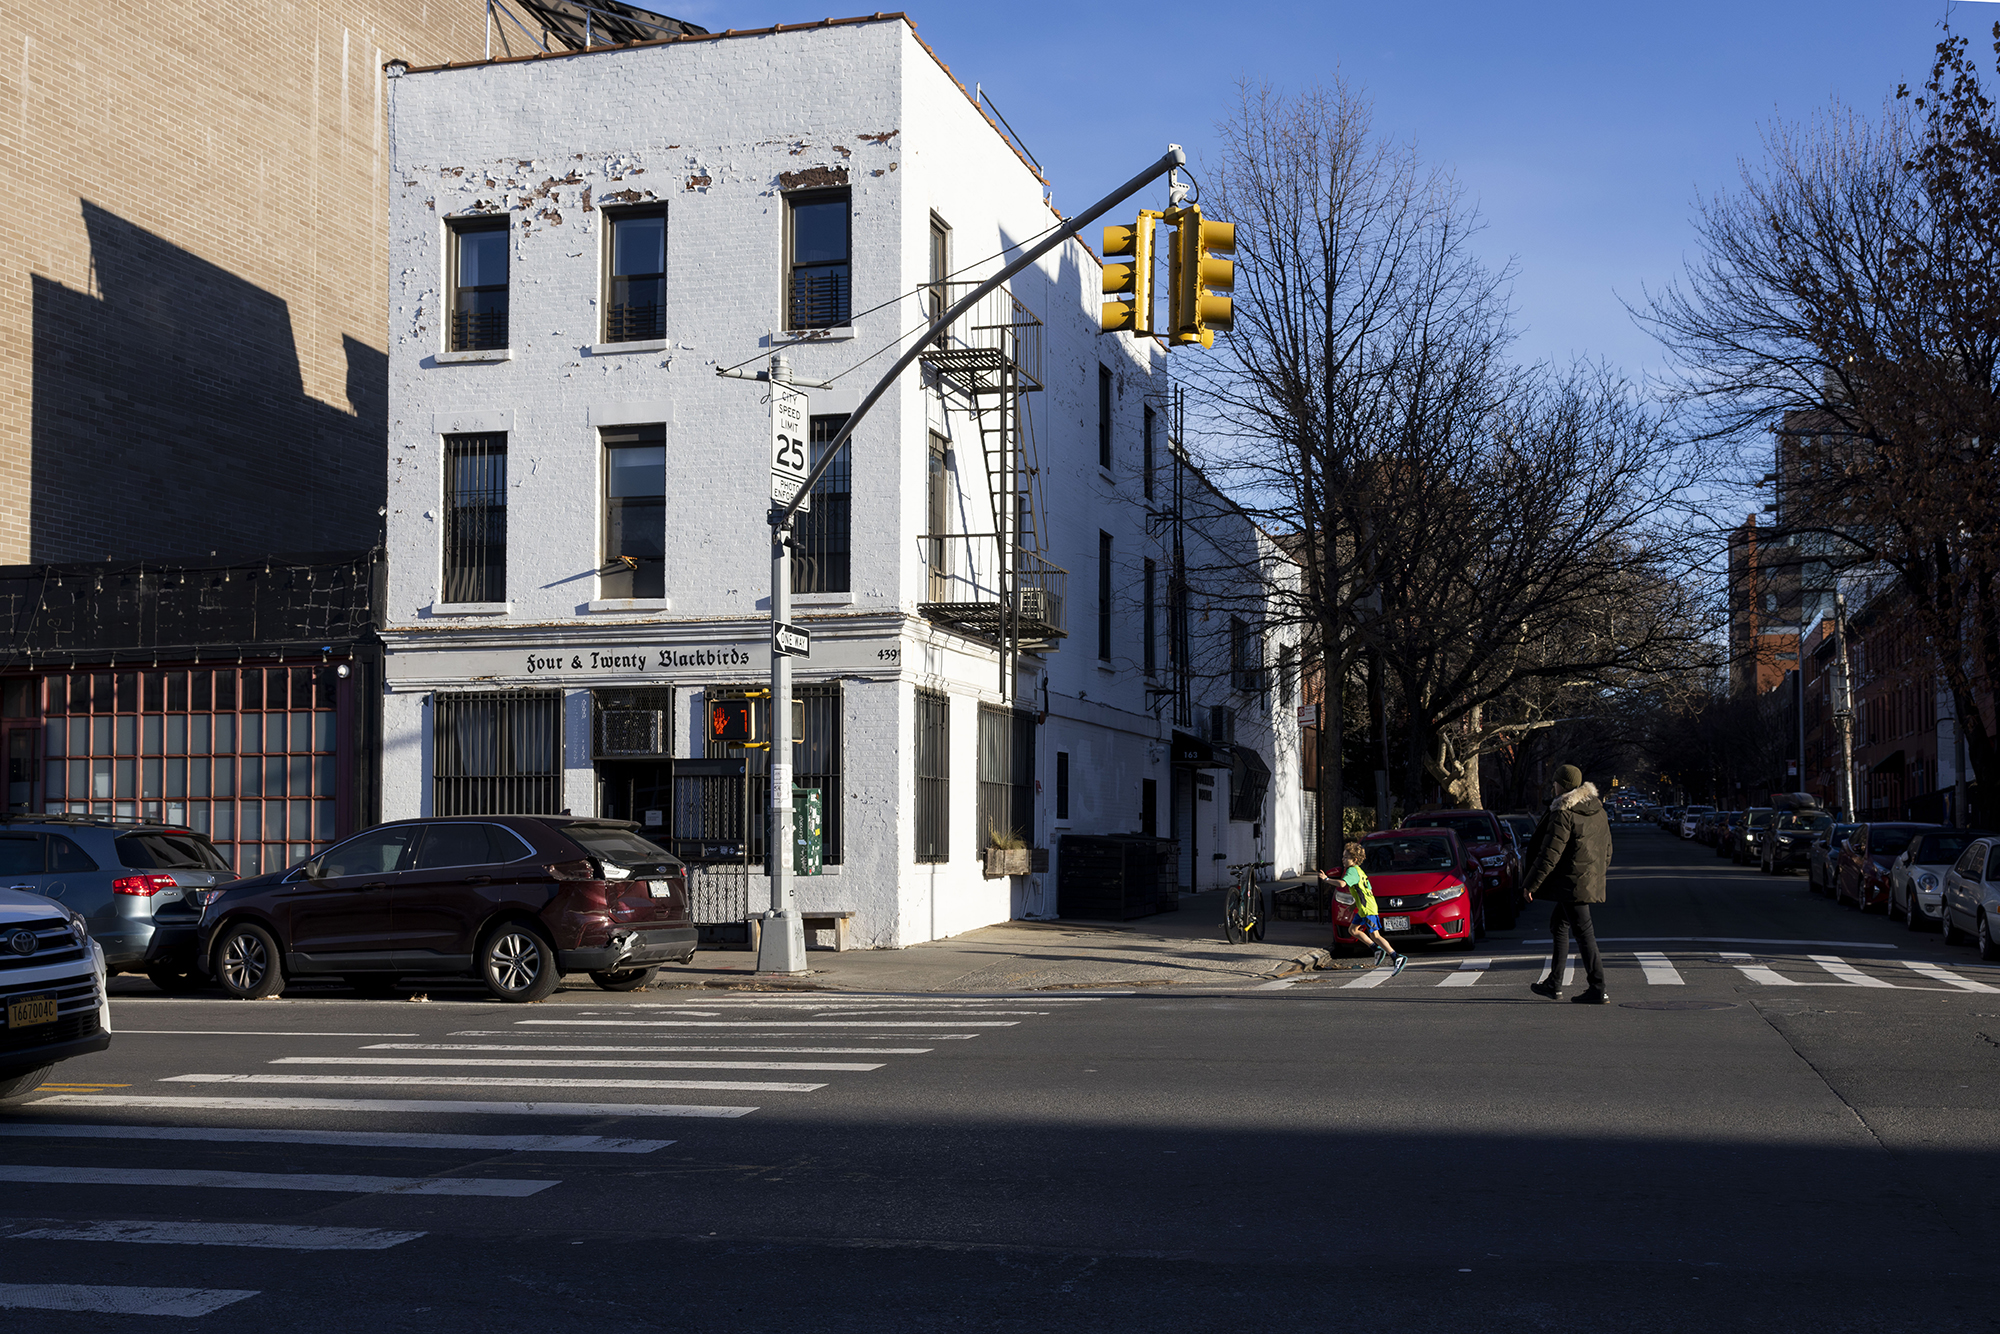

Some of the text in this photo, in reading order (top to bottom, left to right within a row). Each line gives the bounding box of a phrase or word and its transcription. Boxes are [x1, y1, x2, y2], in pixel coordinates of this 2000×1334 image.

[782, 391, 798, 405] CITY
[778, 404, 800, 420] SPEED
[780, 418, 798, 433] LIMIT
[776, 434, 804, 471] 25
[779, 479, 800, 493] PHOTO
[774, 488, 806, 505] ENFORD
[781, 632, 806, 648] ONE WAY
[526, 649, 750, 674] Four & Twenty Blackbirds
[878, 649, 897, 661] 439
[12, 1000, 54, 1022] T667004C
